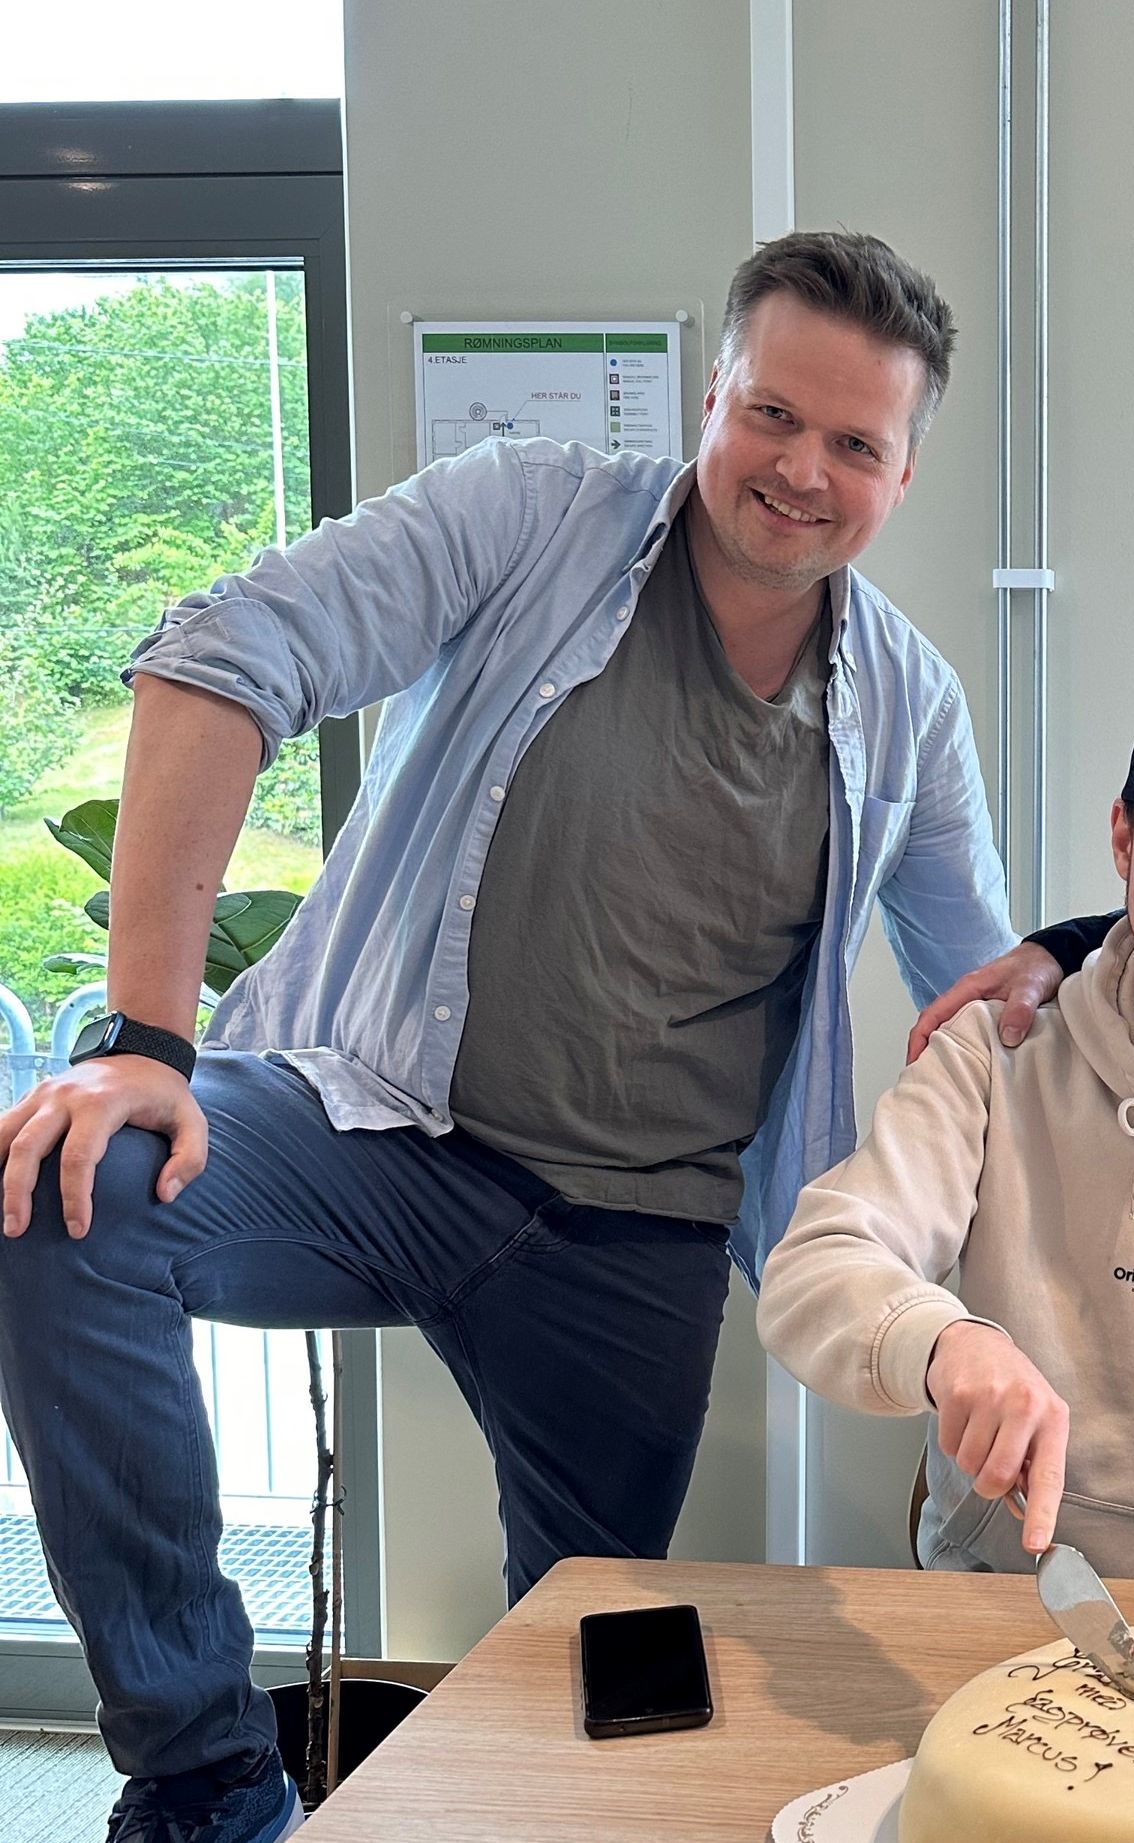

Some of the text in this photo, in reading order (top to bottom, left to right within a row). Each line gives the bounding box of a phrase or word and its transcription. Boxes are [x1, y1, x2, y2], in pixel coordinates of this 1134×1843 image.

[464, 337, 563, 349] RØMNINGSPLAN
[531, 391, 582, 400] HER STÅR DU
